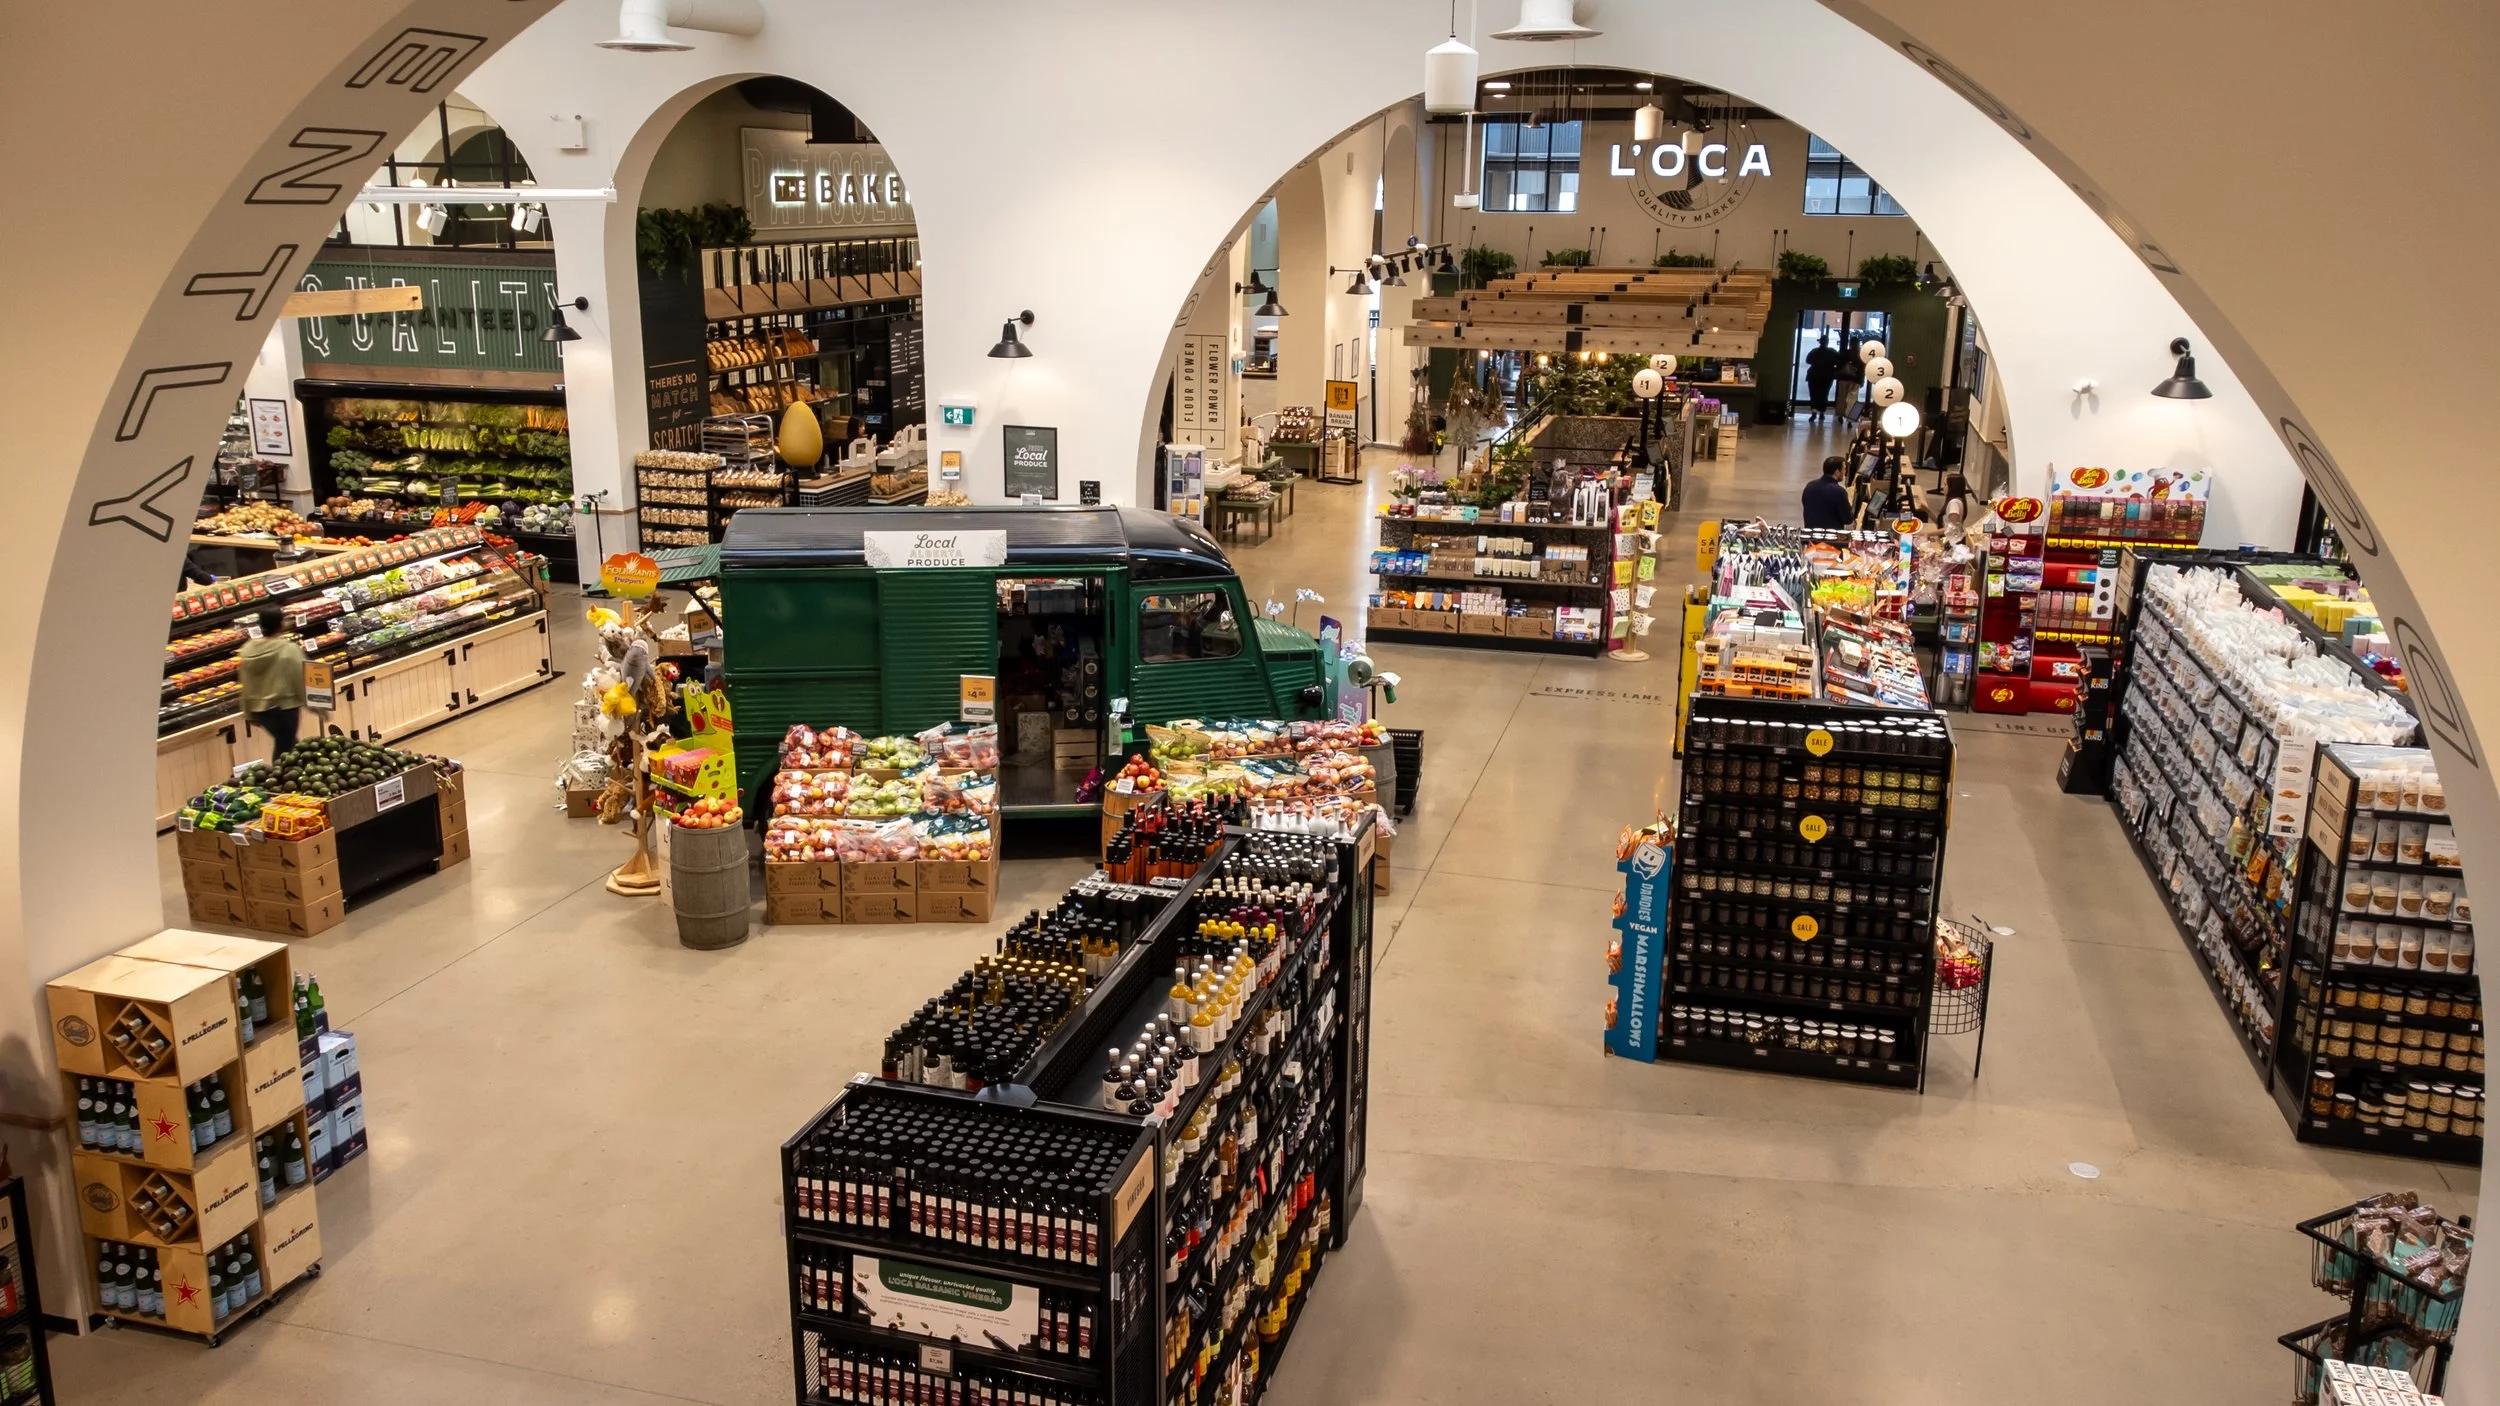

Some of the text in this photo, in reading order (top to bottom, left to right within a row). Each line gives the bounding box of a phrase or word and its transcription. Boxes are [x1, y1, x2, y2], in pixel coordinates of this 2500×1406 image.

[1610, 144, 1772, 177] L'OCA
[777, 179, 806, 199] THE
[1638, 189, 1742, 223] QUALITY MARKET
[1868, 349, 1876, 358] 4
[1659, 360, 1668, 370] 2
[1877, 367, 1885, 377] 3
[649, 372, 698, 390] THERE'S NO
[1183, 341, 1195, 423] FLOUR POWER
[1208, 343, 1219, 424] FLOWER POWER
[651, 386, 699, 410] MATCH
[1884, 388, 1894, 399] 2
[1328, 412, 1353, 420] BANANA
[653, 423, 700, 450] SCRATCH
[1014, 446, 1048, 461] Local
[1013, 460, 1048, 468] PRODUCE
[2083, 468, 2101, 480] Jelly
[2076, 475, 2096, 488] Belly
[2012, 499, 2032, 512] Jelly
[2004, 507, 2028, 521] Belly
[914, 533, 958, 549] Local
[908, 549, 963, 558] ALBERTA
[907, 558, 966, 567] PRODUCE
[2090, 682, 2109, 690] KIND
[1544, 686, 1662, 701] EXPRESS LANE
[1995, 723, 2039, 732] LINE
[1811, 738, 1828, 747] SALE
[1805, 823, 1822, 832] SALE
[1638, 882, 1654, 922] DANDIES
[1629, 921, 1658, 935] VEGAN
[1797, 924, 1813, 932] SALE
[1628, 934, 1649, 1048] MARSHMALLOWS
[181, 1017, 229, 1046] S.PELLEGRINO
[254, 1066, 297, 1095] S.PELLEGRINO
[204, 1182, 249, 1215] S.PELLEGRINO
[273, 1222, 314, 1255] S.PELLEGRINO
[888, 1276, 1003, 1306] L'OCA BALSAMIC VINEGAR
[975, 1285, 997, 1296] quality
